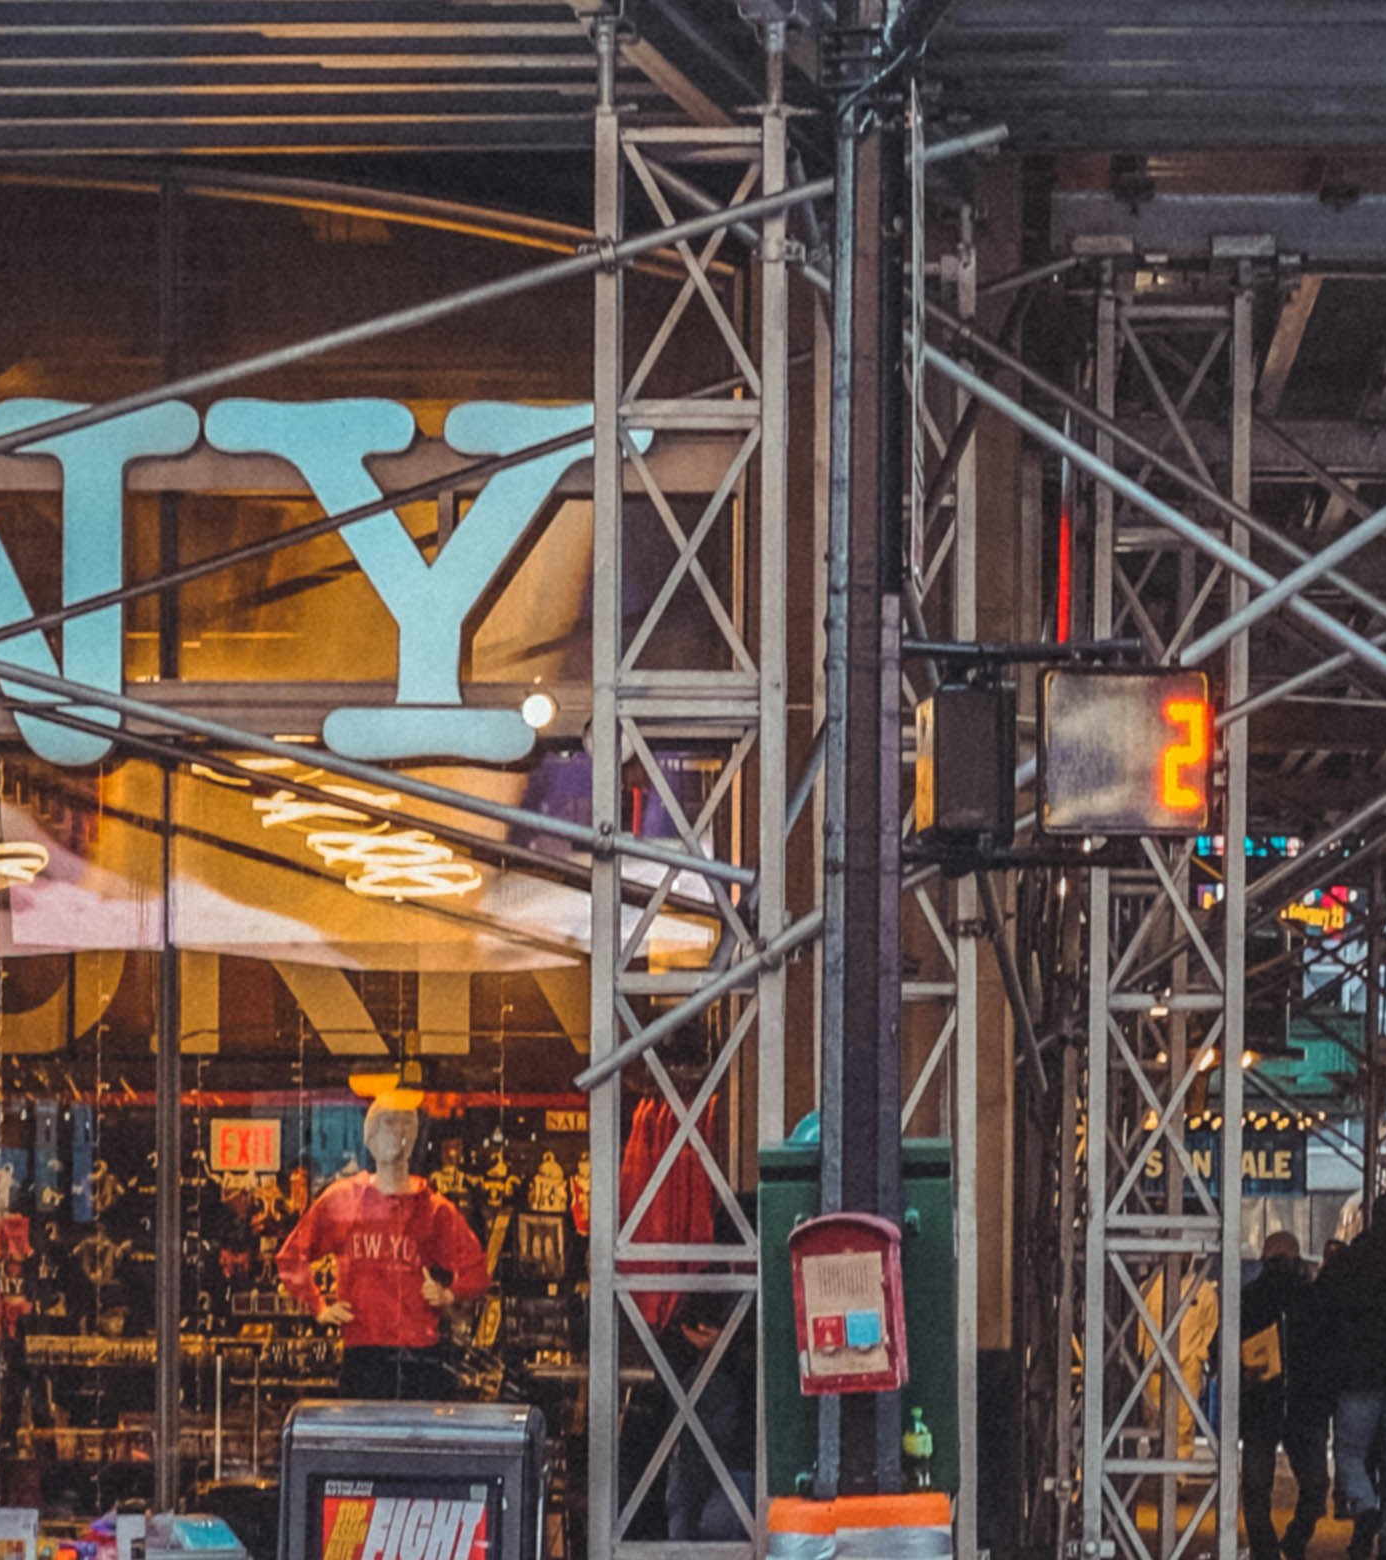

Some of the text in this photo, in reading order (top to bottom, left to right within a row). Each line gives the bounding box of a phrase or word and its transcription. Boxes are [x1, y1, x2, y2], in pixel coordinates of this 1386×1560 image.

[1161, 702, 1203, 808] 2
[220, 1126, 273, 1166] EXIT
[351, 1233, 381, 1259] EW
